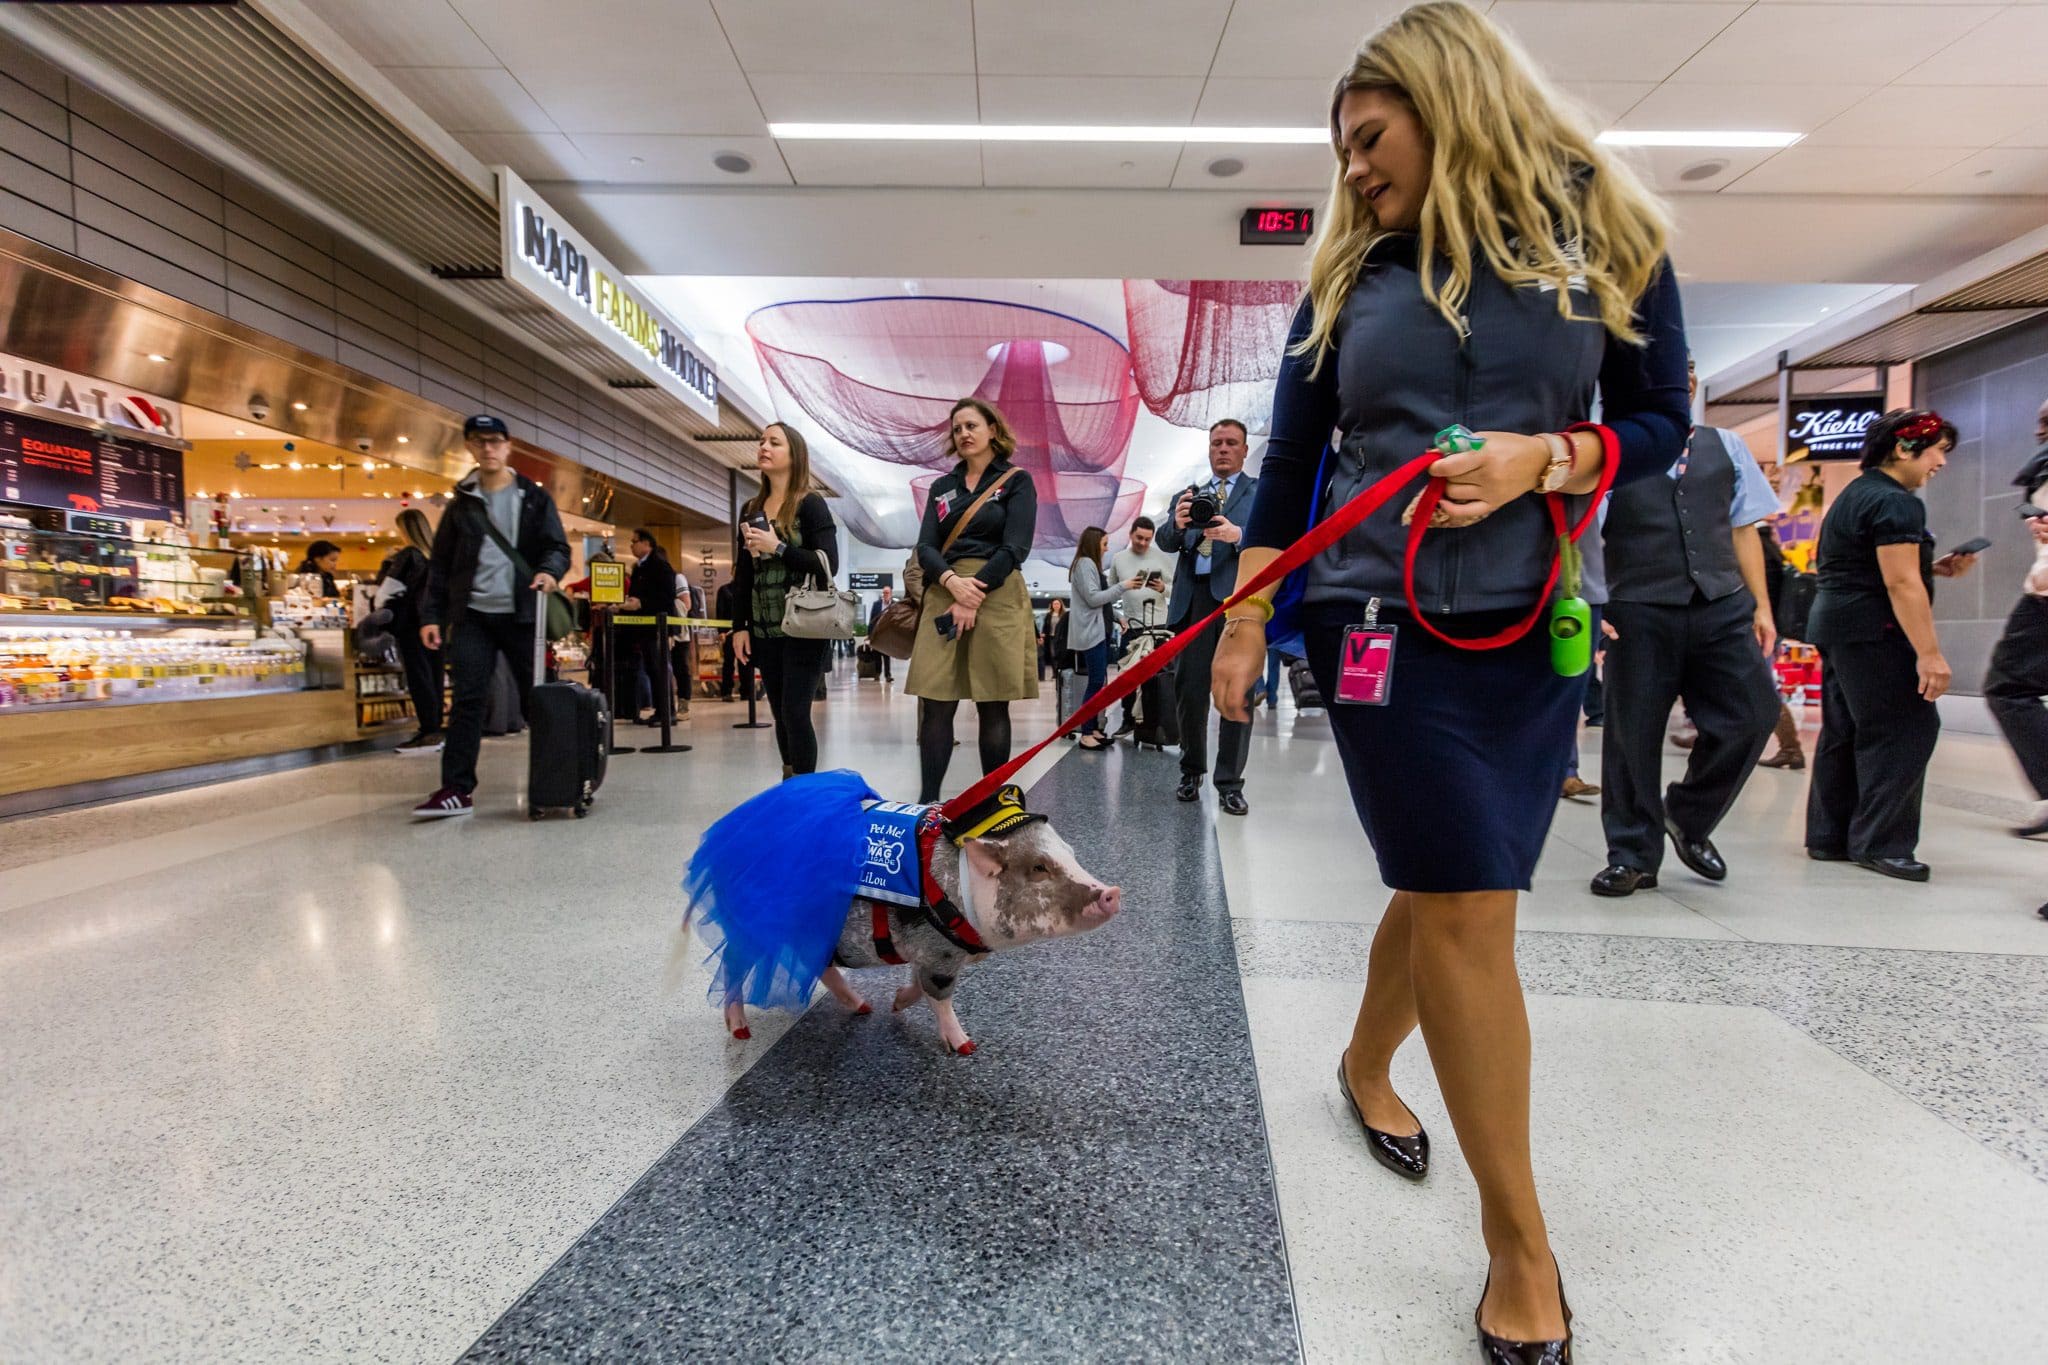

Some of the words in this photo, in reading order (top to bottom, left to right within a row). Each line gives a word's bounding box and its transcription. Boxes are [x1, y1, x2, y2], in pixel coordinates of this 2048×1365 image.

[1257, 211, 1309, 231] 10:51
[523, 206, 591, 304] NAPA
[595, 271, 660, 357] FARMS
[661, 329, 718, 404] MARKET
[0, 366, 174, 436] UATR
[1789, 409, 1880, 438] Kiehl'
[22, 437, 93, 461] EQUATOR
[596, 566, 618, 575] NAPA
[870, 823, 885, 834] Pet
[886, 825, 906, 839] Me!
[868, 845, 892, 859] WAG
[869, 856, 896, 866] IGADE
